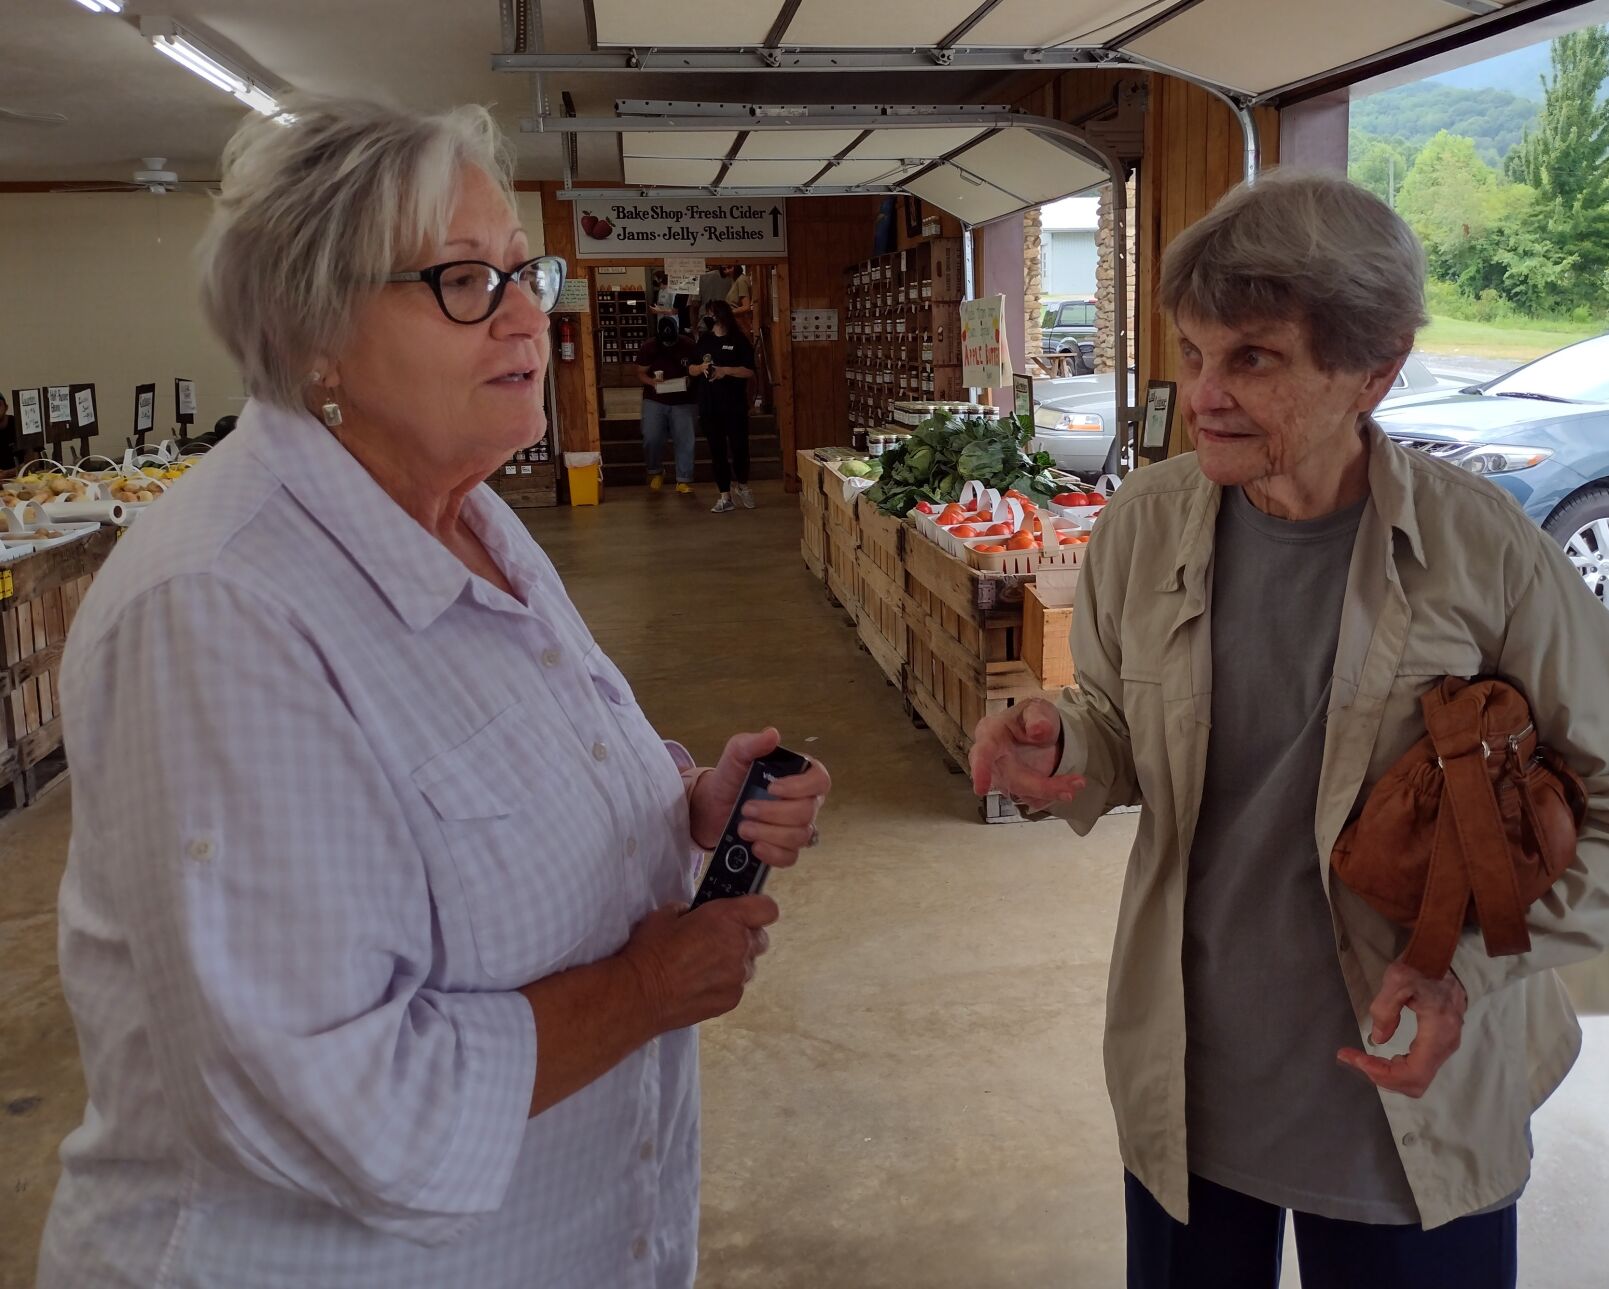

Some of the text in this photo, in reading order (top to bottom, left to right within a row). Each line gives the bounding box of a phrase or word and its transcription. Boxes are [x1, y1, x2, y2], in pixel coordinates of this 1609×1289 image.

[611, 205, 650, 221] Bake
[729, 205, 766, 220] Cider
[617, 225, 764, 246] Jams Jelly Relishes
